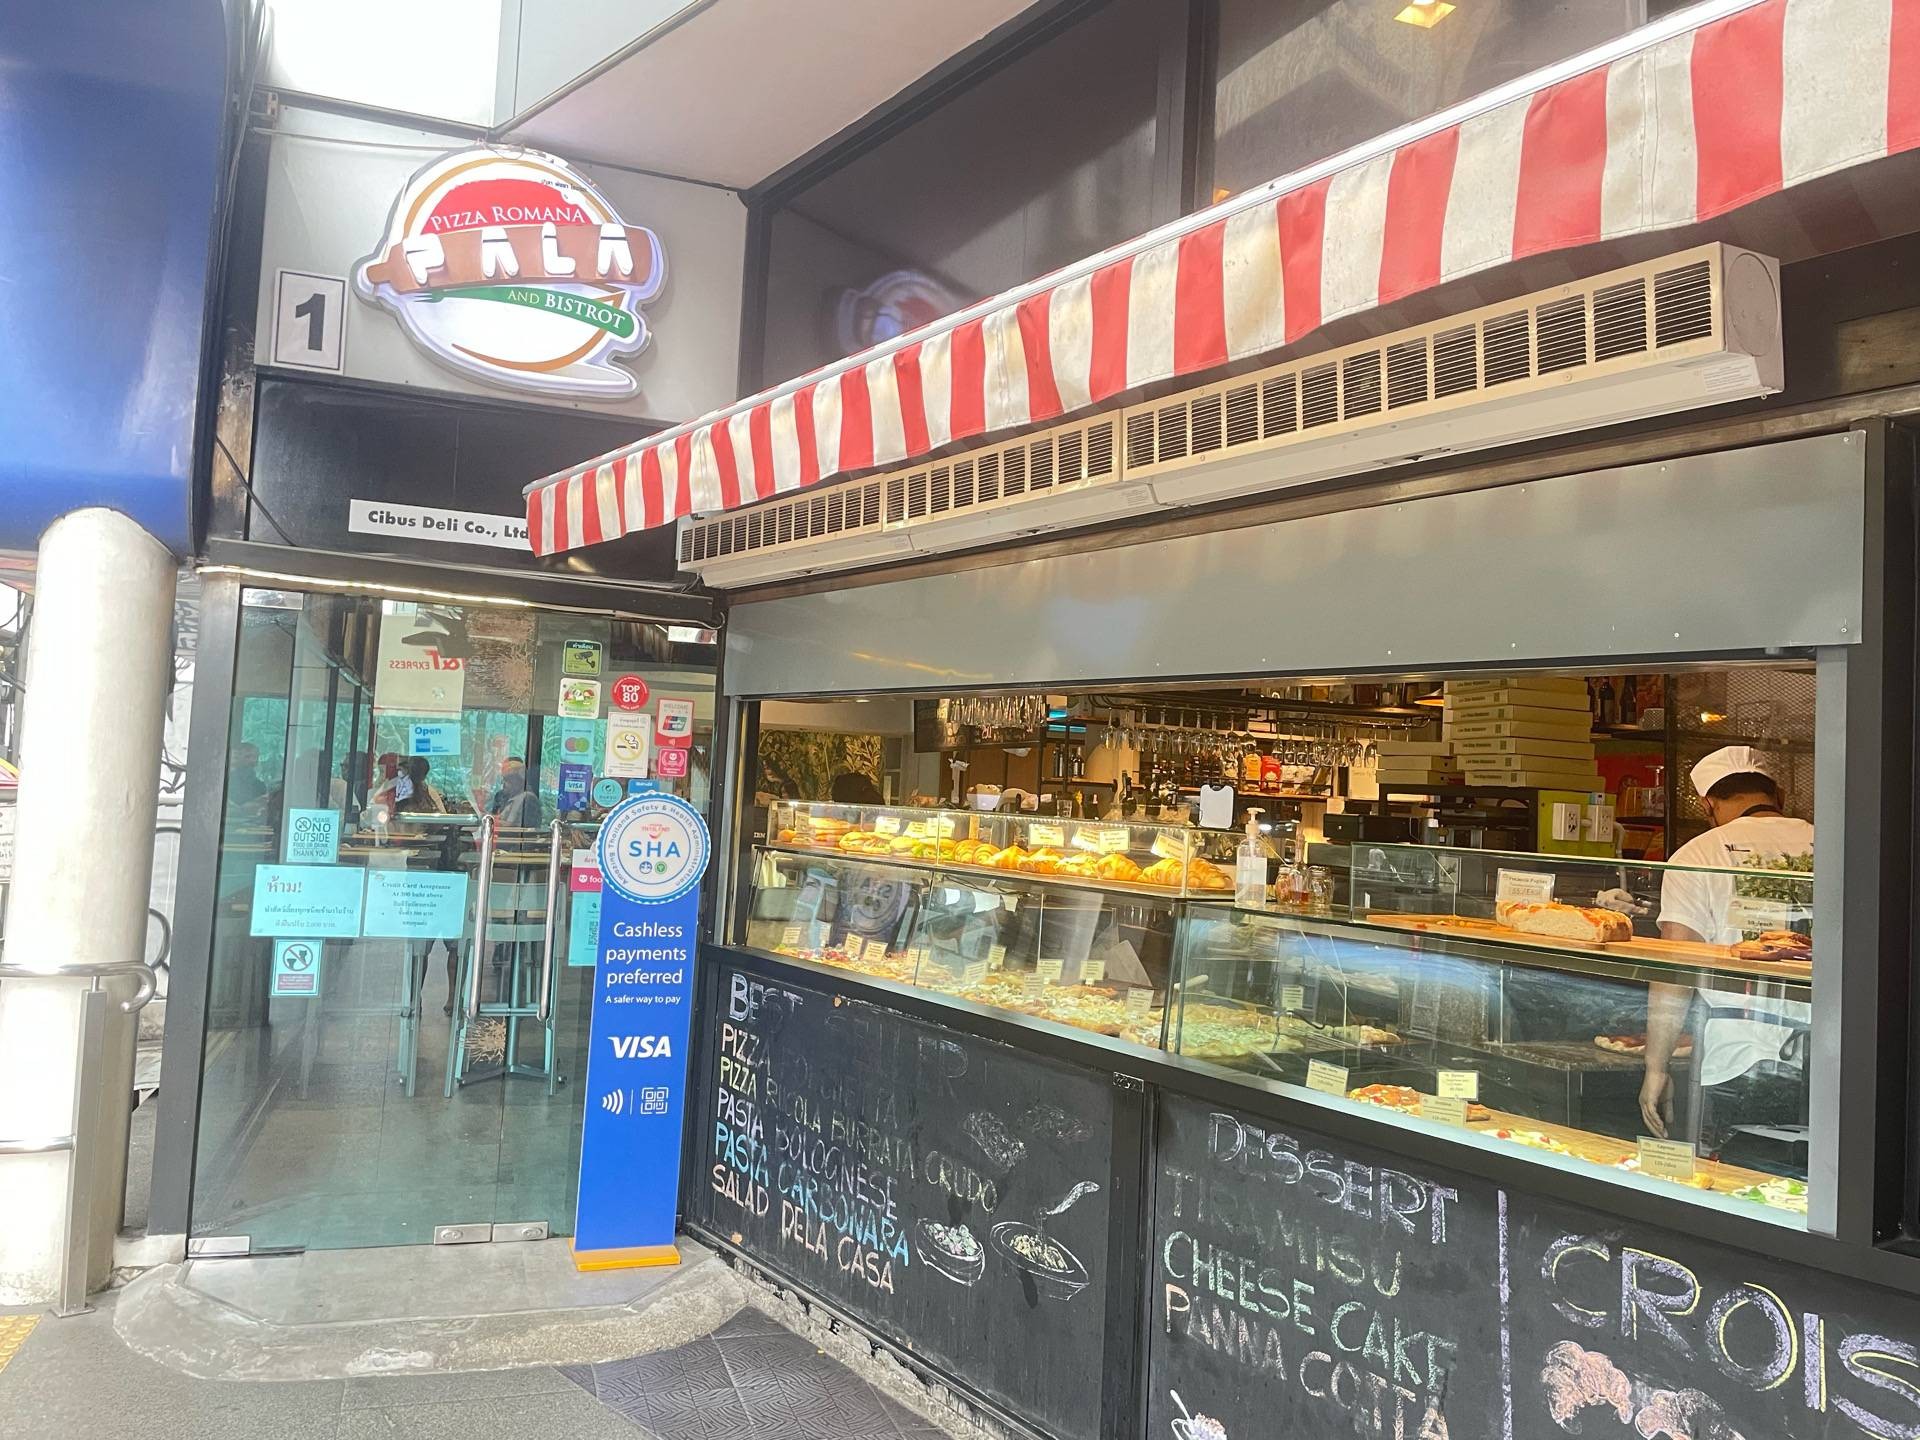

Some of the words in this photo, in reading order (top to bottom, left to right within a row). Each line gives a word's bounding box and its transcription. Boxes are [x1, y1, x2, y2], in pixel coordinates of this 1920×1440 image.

[430, 210, 484, 231] PIZZA
[493, 205, 585, 224] ROMANA
[507, 288, 541, 305] AND
[543, 291, 626, 330] BISTROT
[295, 293, 325, 351] 1
[368, 510, 417, 528] Cibus
[422, 514, 459, 533] Deli
[464, 519, 498, 538] Co.,
[621, 684, 641, 694] TOP
[622, 693, 639, 703] 80
[414, 726, 442, 736] Open
[293, 832, 331, 843] OUTSIDE
[312, 823, 331, 833] NO
[608, 814, 631, 849] Thailand
[631, 804, 659, 816] Safety
[629, 840, 681, 858] SHA
[613, 922, 683, 938] Cashless
[606, 946, 687, 966] payments
[606, 969, 683, 989] preferred
[606, 995, 612, 1004] A
[614, 994, 634, 1004] safer
[636, 996, 653, 1006] way
[654, 995, 663, 1004] to
[666, 996, 681, 1006] pay
[608, 1036, 672, 1059] VISA
[717, 1087, 764, 1139] PASTA
[719, 1056, 757, 1100] PIZZA
[924, 1150, 999, 1215] CRUDO
[715, 1121, 769, 1188] PASTA
[1209, 1112, 1458, 1244] DESSERT
[711, 1164, 770, 1217] SALAD
[837, 1236, 895, 1295] CASA
[1163, 1230, 1315, 1335] CHEESE
[1330, 1300, 1458, 1391] CAKE
